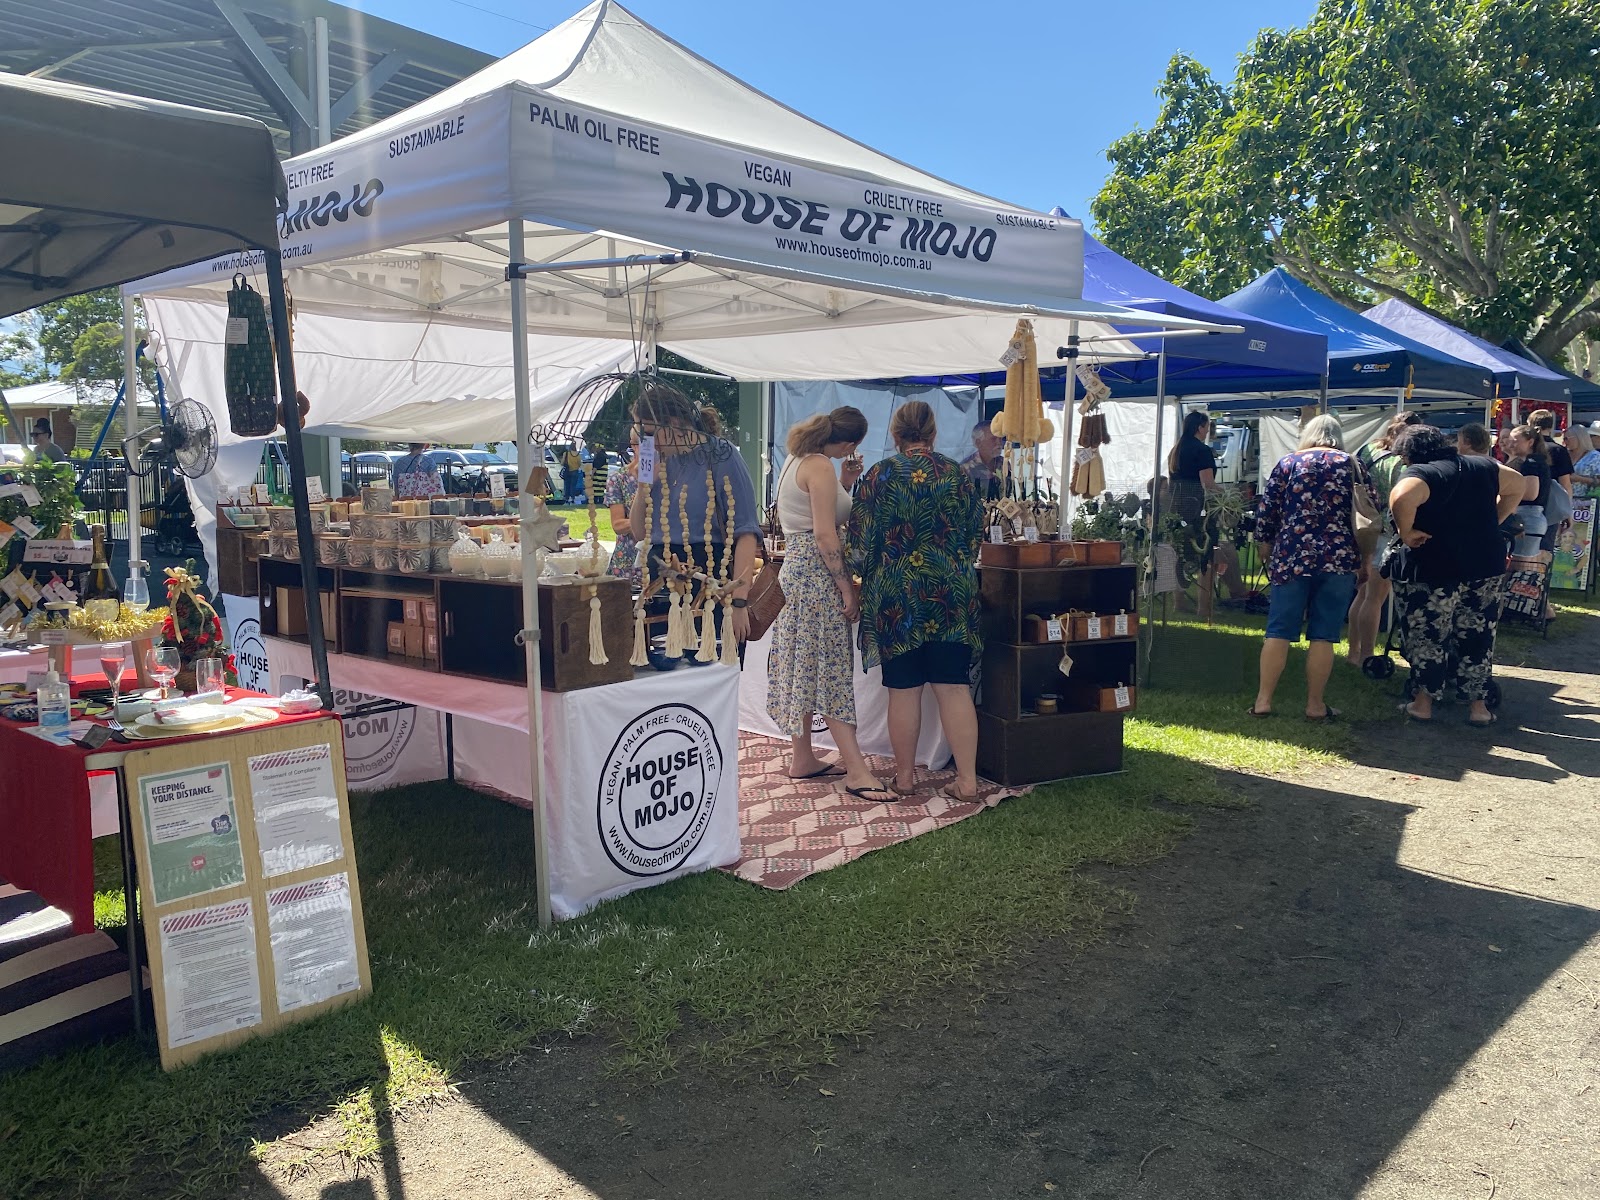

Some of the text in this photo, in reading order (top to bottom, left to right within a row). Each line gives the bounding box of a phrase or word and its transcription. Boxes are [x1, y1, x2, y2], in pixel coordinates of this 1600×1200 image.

[388, 115, 466, 159] SUSTAINABLE
[529, 102, 660, 156] PALM OIL FREE
[286, 161, 335, 190] ELTY FREE
[744, 160, 792, 188] VEGAN
[285, 177, 385, 233] MOJO
[662, 171, 998, 263] HOUSE OF MOJO
[863, 189, 944, 218] CRUELTY FREE
[995, 213, 1058, 232] SUSTAINABLE
[775, 236, 932, 271] www.houseofmojo.com.au
[640, 458, 653, 472] $15
[1049, 629, 1061, 637] $14
[240, 652, 269, 673] HOUSE
[250, 669, 259, 685] OF
[606, 713, 716, 806] VEGAN PALM FREE CRUELTY FREE
[625, 746, 699, 787] HOUSE
[151, 781, 186, 796] KEEPING
[152, 785, 214, 804] YOUR DISTANCE.
[650, 774, 678, 801] OF
[634, 791, 695, 830] MOJO
[608, 791, 714, 868] www.houseofmojo.com.au
